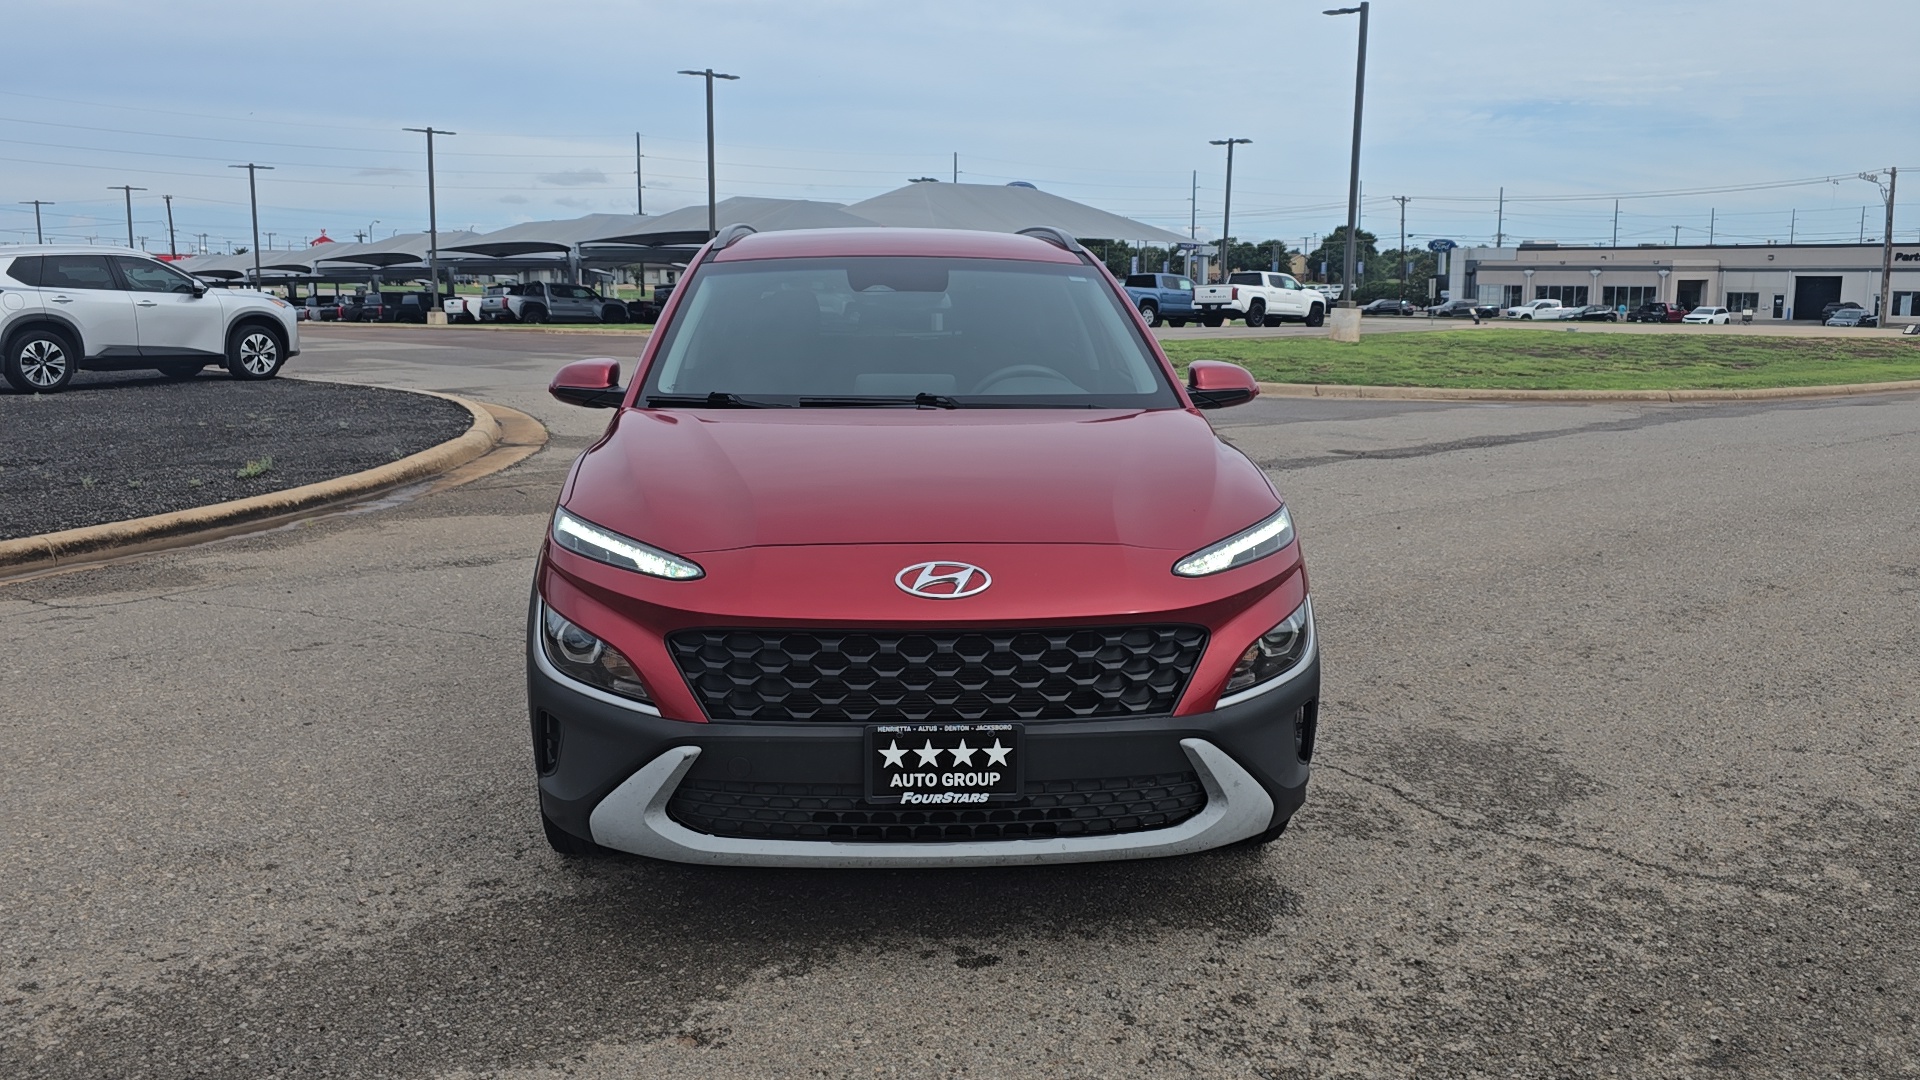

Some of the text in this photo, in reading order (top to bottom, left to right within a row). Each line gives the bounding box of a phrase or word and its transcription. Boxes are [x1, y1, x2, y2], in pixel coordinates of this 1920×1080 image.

[1433, 241, 1451, 250] Ford
[877, 725, 912, 733] HENRIETTA
[889, 772, 1001, 788] AUTO GROUP
